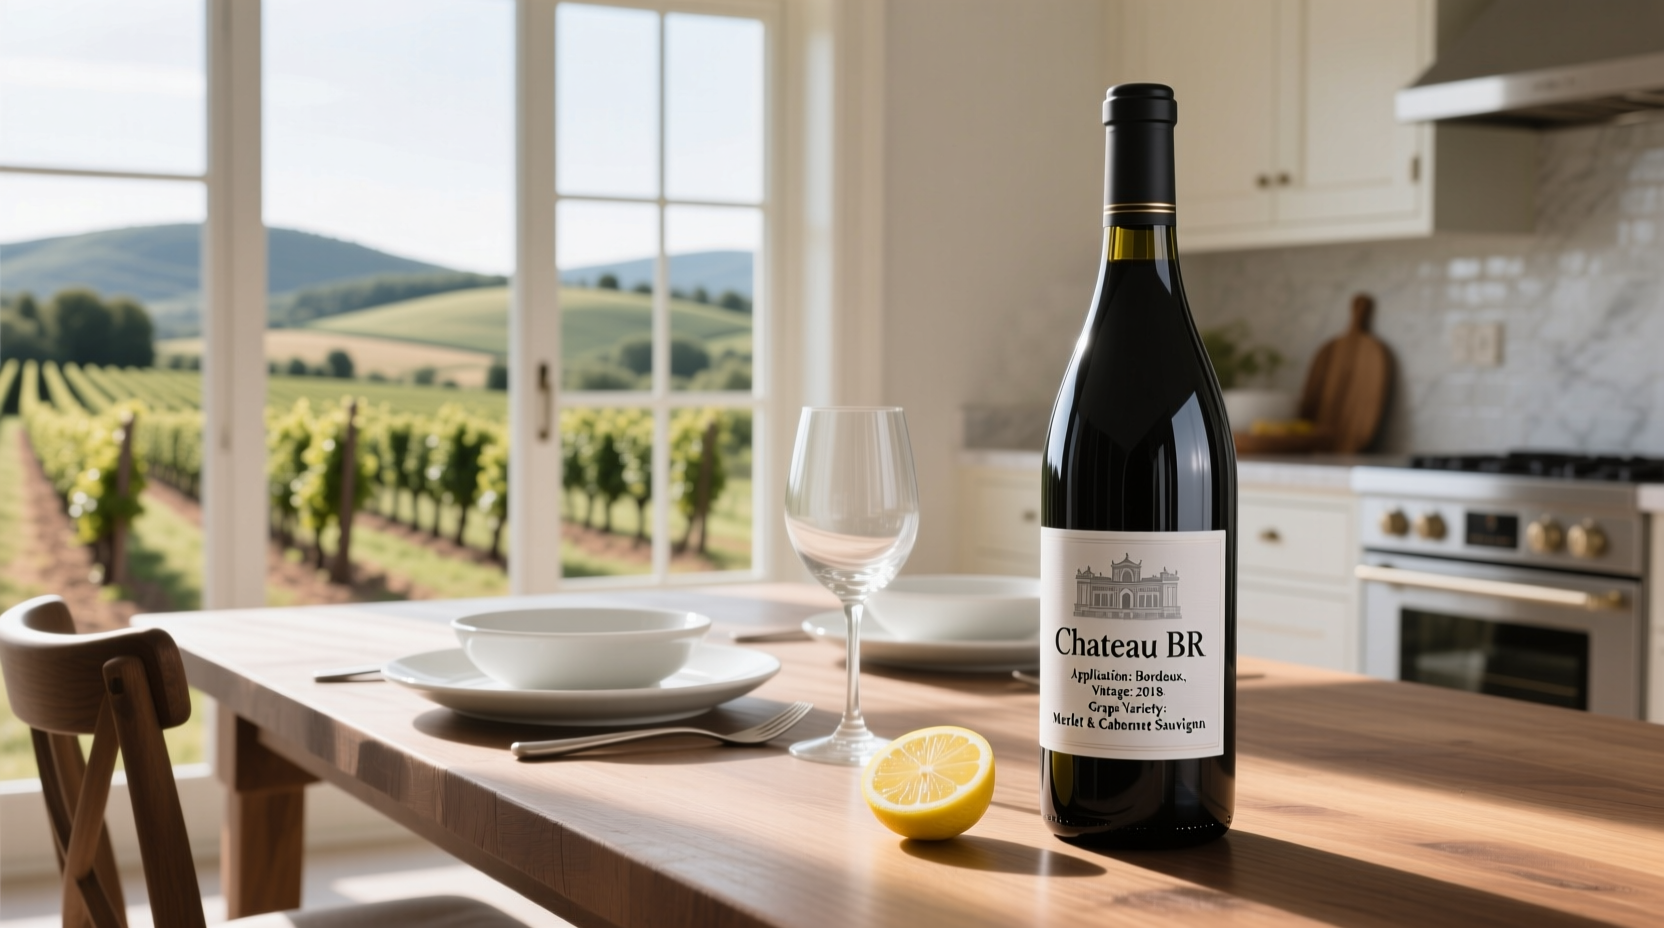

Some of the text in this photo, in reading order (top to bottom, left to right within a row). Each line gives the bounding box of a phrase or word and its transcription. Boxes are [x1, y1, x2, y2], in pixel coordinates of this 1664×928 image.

[1055, 626, 1206, 659] Chateau BR
[1087, 716, 1096, 729] &
